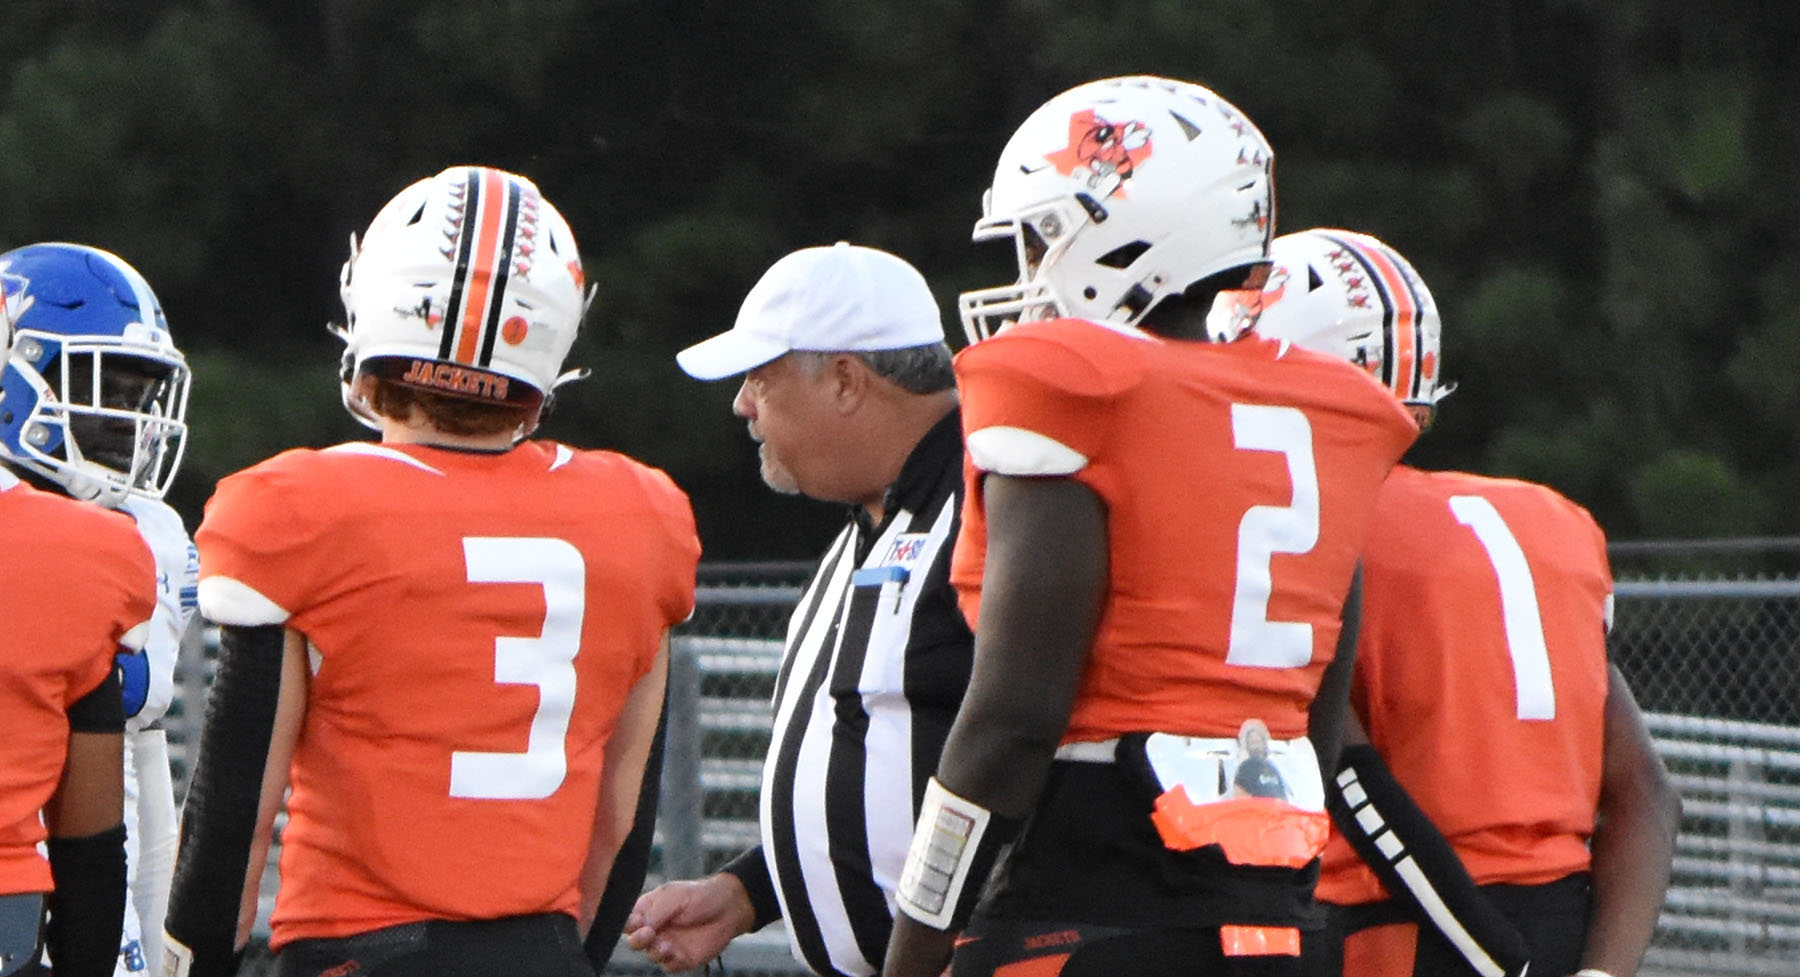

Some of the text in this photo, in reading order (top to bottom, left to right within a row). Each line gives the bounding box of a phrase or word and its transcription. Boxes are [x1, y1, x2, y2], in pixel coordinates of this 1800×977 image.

[403, 359, 509, 400] JACKETS
[1226, 403, 1320, 669] 2
[1449, 495, 1556, 721] 1
[449, 536, 586, 800] 3
